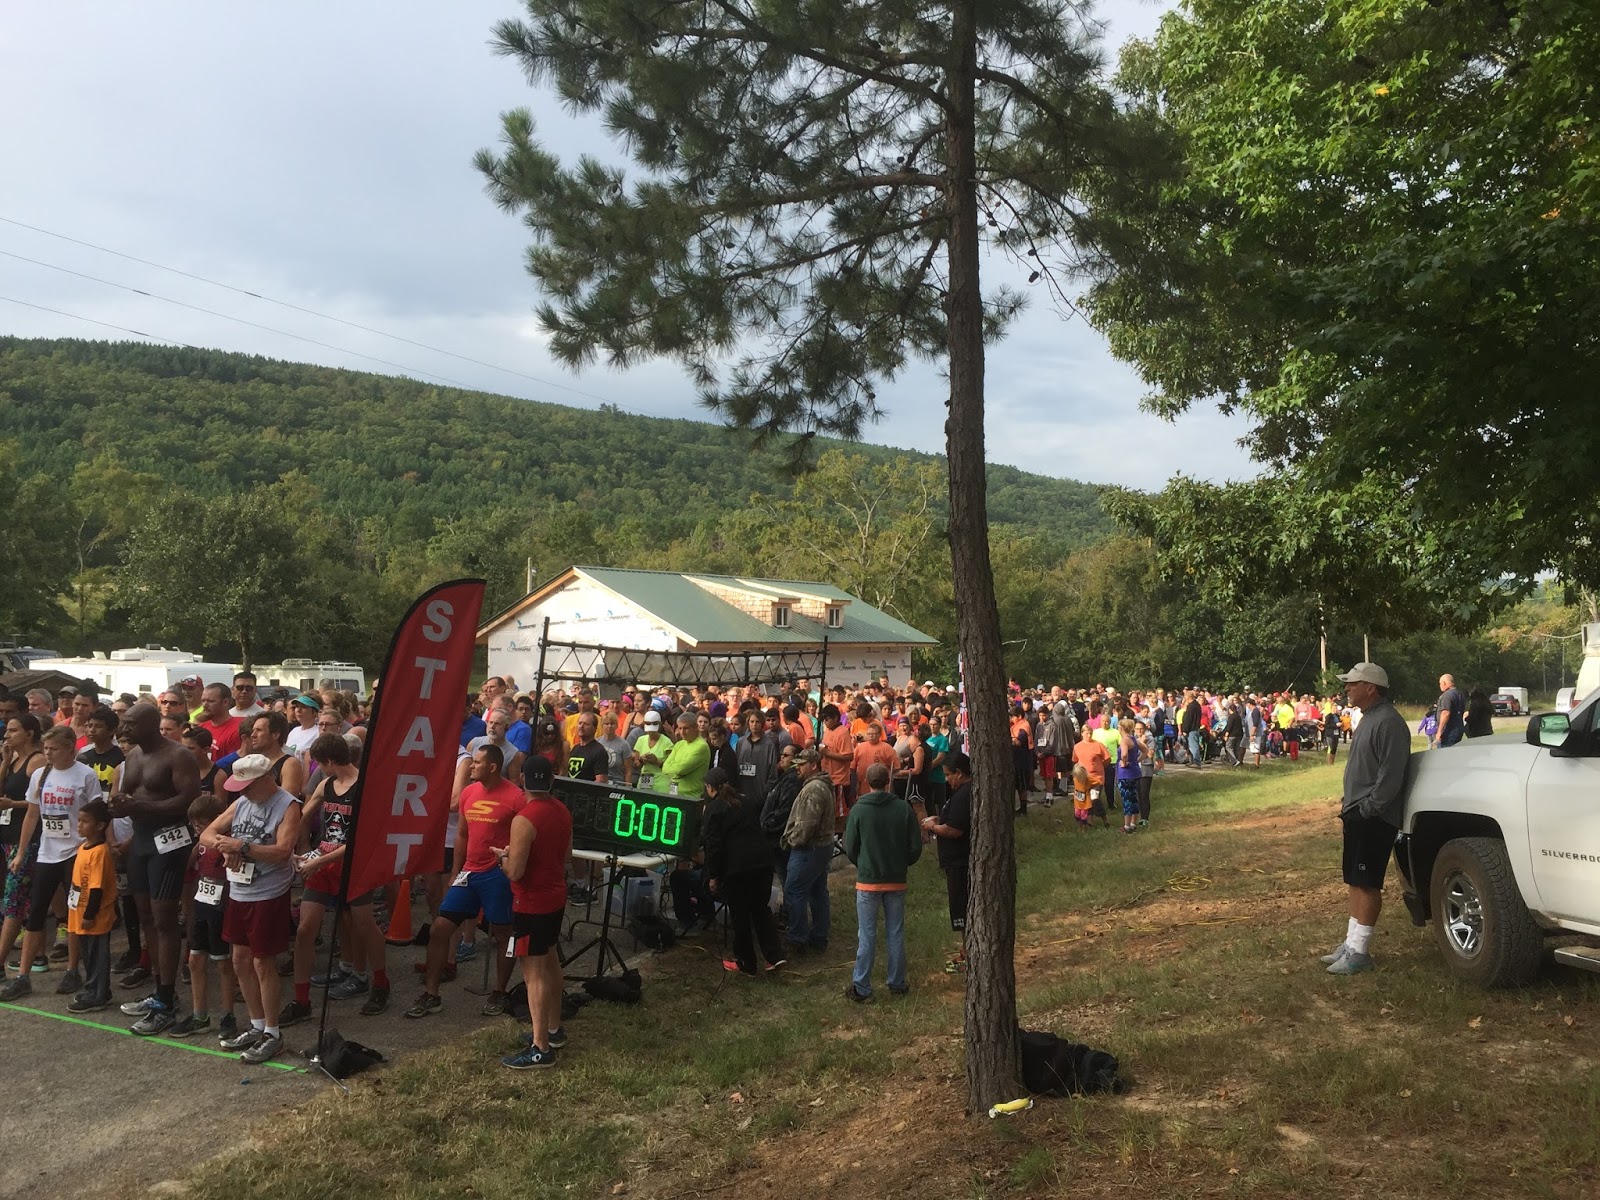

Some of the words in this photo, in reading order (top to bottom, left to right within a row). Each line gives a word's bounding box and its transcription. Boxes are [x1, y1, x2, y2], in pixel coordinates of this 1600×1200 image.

[386, 599, 454, 875] START
[43, 792, 76, 806] Ebert
[609, 792, 626, 800] GILL
[45, 820, 64, 831] 435
[614, 799, 682, 846] 0:00
[160, 829, 183, 844] 342
[199, 882, 216, 895] 358
